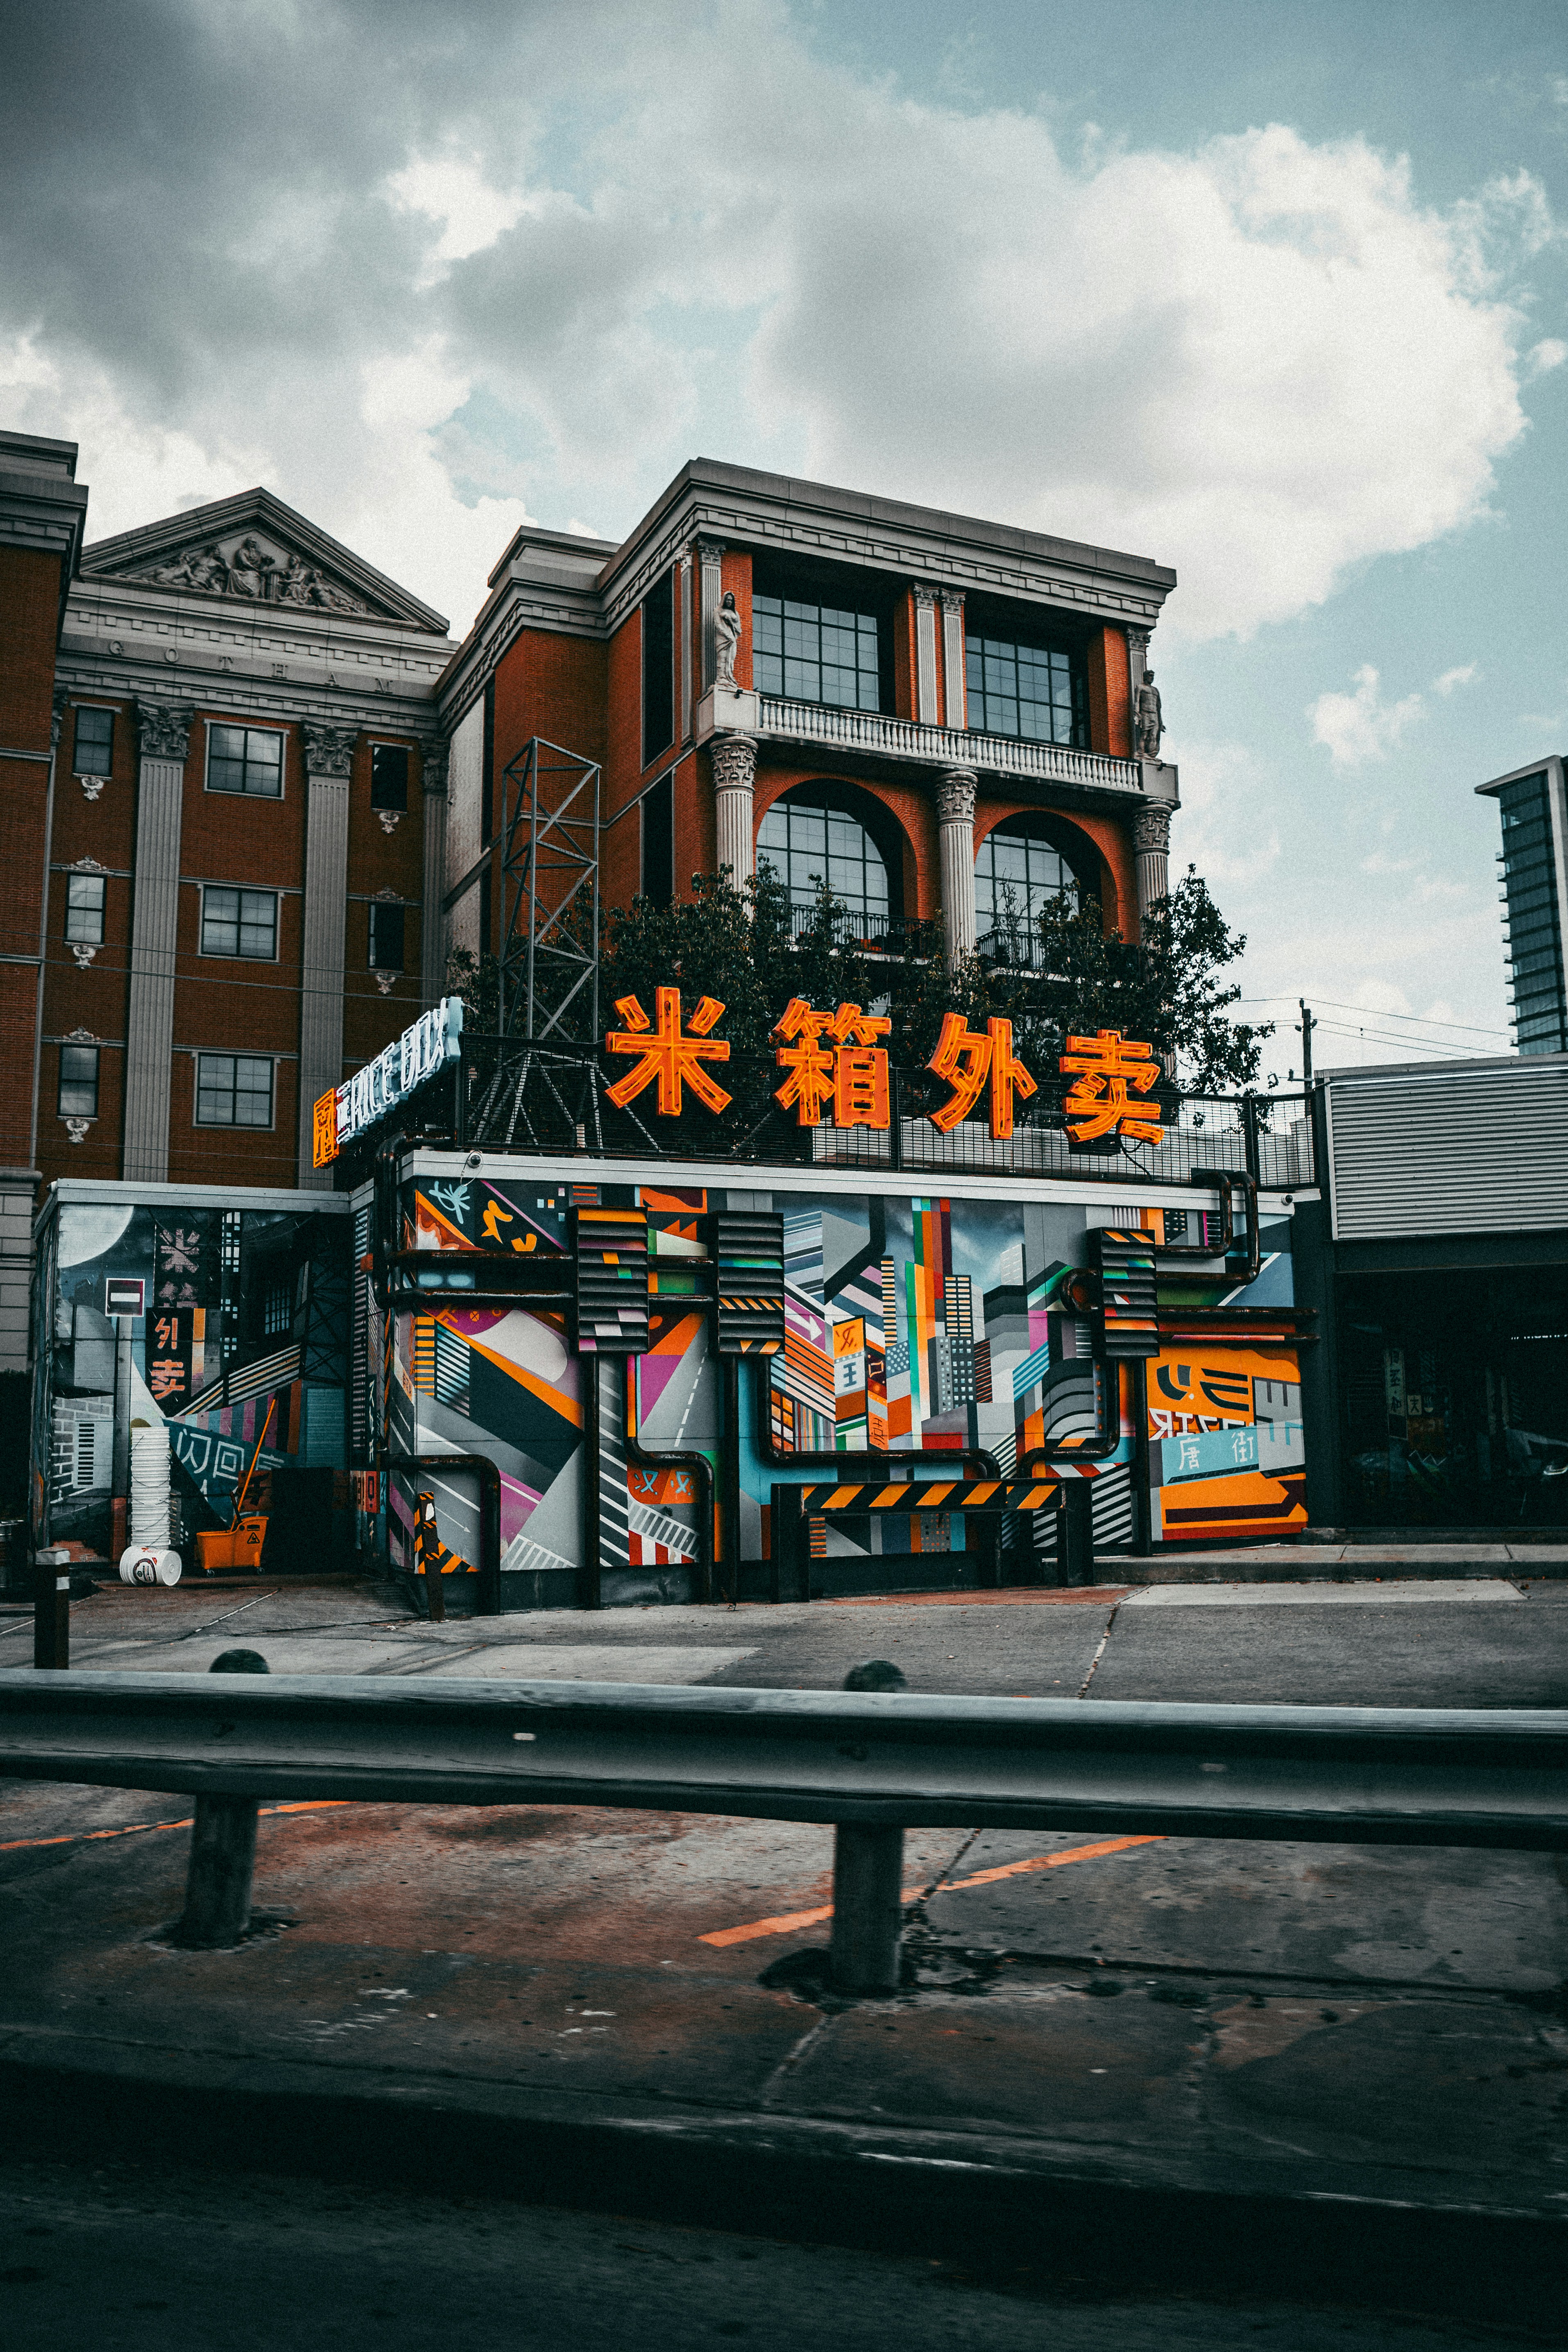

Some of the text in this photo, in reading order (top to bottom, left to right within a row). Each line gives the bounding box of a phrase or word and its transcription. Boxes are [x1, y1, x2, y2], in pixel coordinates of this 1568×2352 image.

[108, 640, 393, 694] GOTHAM
[351, 1041, 395, 1133] RICE
[401, 997, 447, 1092] BOX
[604, 986, 1165, 1146] 米箱外卖
